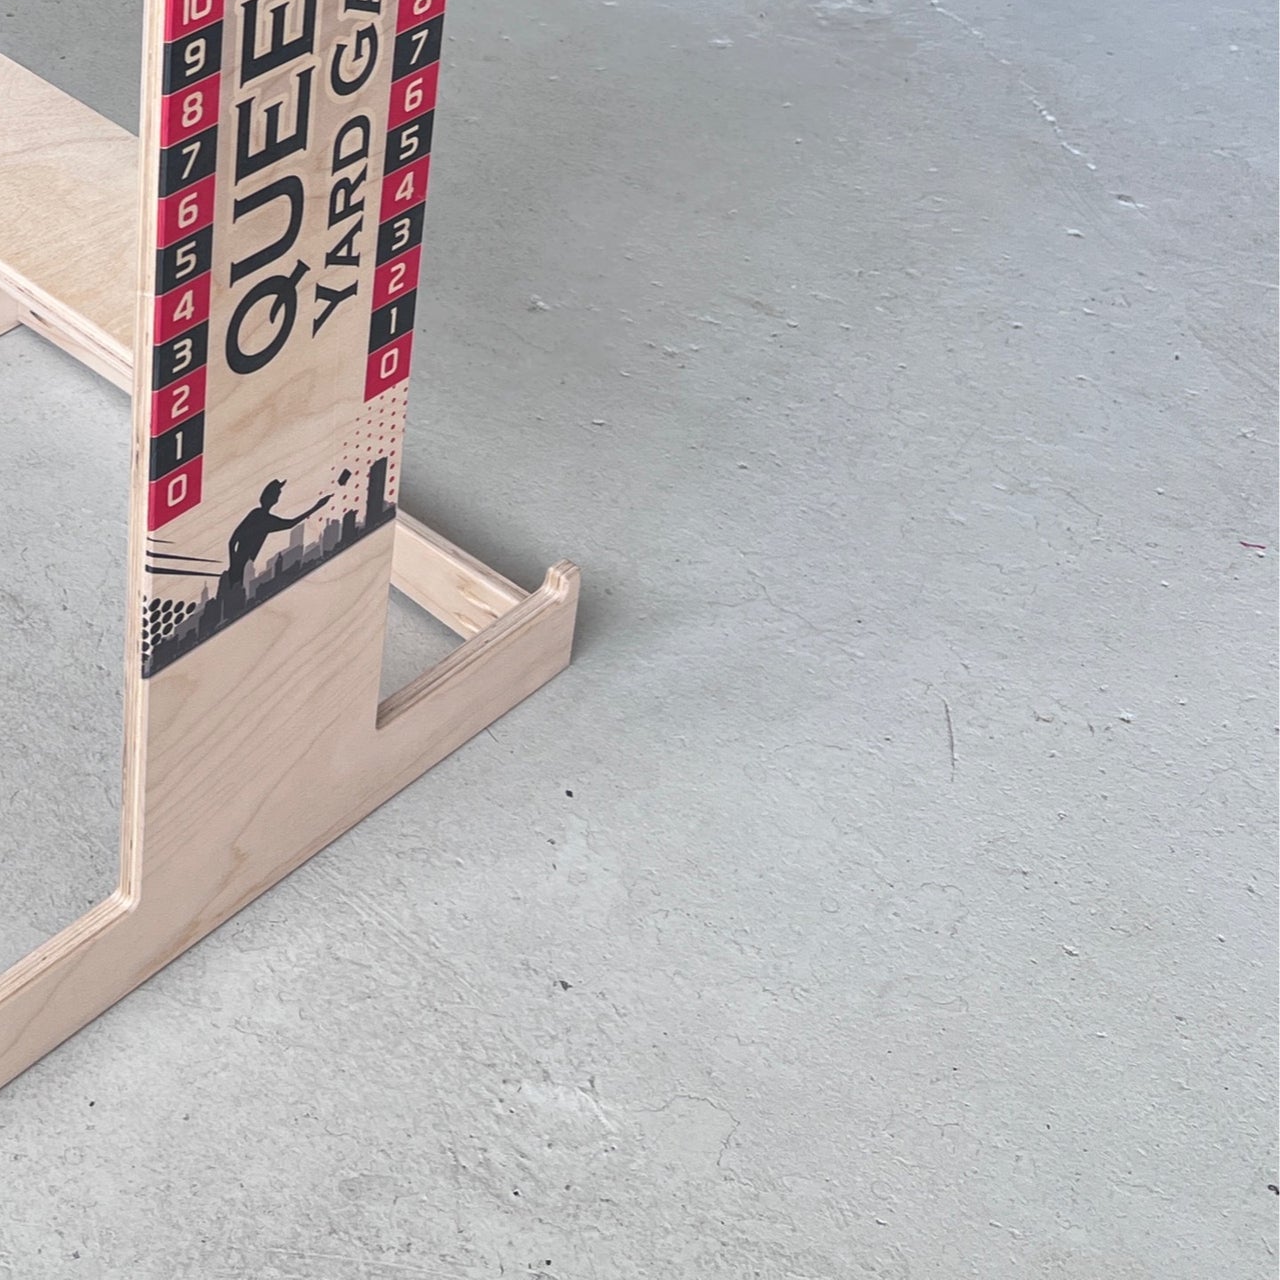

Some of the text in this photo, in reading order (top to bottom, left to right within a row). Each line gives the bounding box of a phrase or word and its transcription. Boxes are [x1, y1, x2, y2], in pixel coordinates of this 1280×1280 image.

[184, 38, 206, 77] 9
[409, 28, 429, 65] 7
[182, 91, 203, 128] 8
[404, 77, 423, 112] 6
[399, 124, 419, 160] 5
[182, 141, 201, 180] 7
[395, 171, 414, 201] 4
[178, 192, 198, 229] 6
[310, 113, 372, 340] YARD
[391, 217, 411, 251] 3
[175, 240, 196, 279] 5
[388, 262, 406, 294] 2
[173, 290, 194, 322] 4
[390, 307, 398, 335] 1
[172, 338, 193, 373] 3
[380, 347, 399, 379] 0
[171, 385, 190, 419] 2
[175, 431, 183, 460] 1
[167, 473, 187, 507] 0
